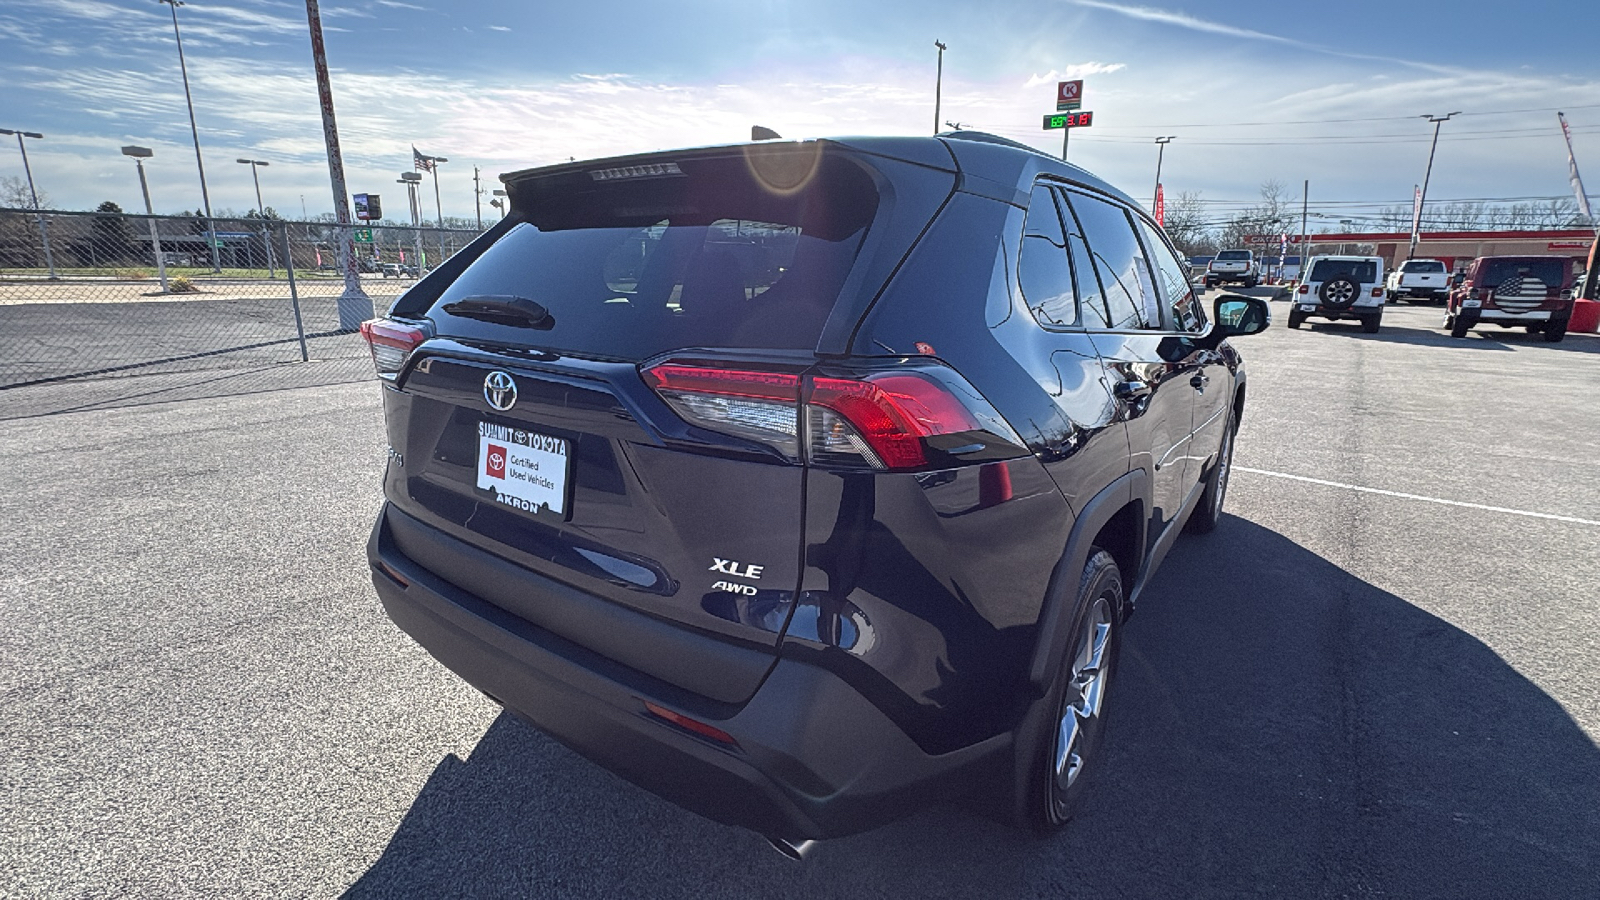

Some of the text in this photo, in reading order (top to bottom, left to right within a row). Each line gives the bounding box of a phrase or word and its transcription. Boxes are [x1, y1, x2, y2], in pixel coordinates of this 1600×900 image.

[478, 421, 566, 456] SUMMIT TOYOTA
[510, 454, 539, 471] Certified
[510, 468, 555, 490] Used Vehicles
[496, 493, 539, 514] AKRON
[708, 557, 764, 579] XLE
[711, 581, 758, 596] AWD
